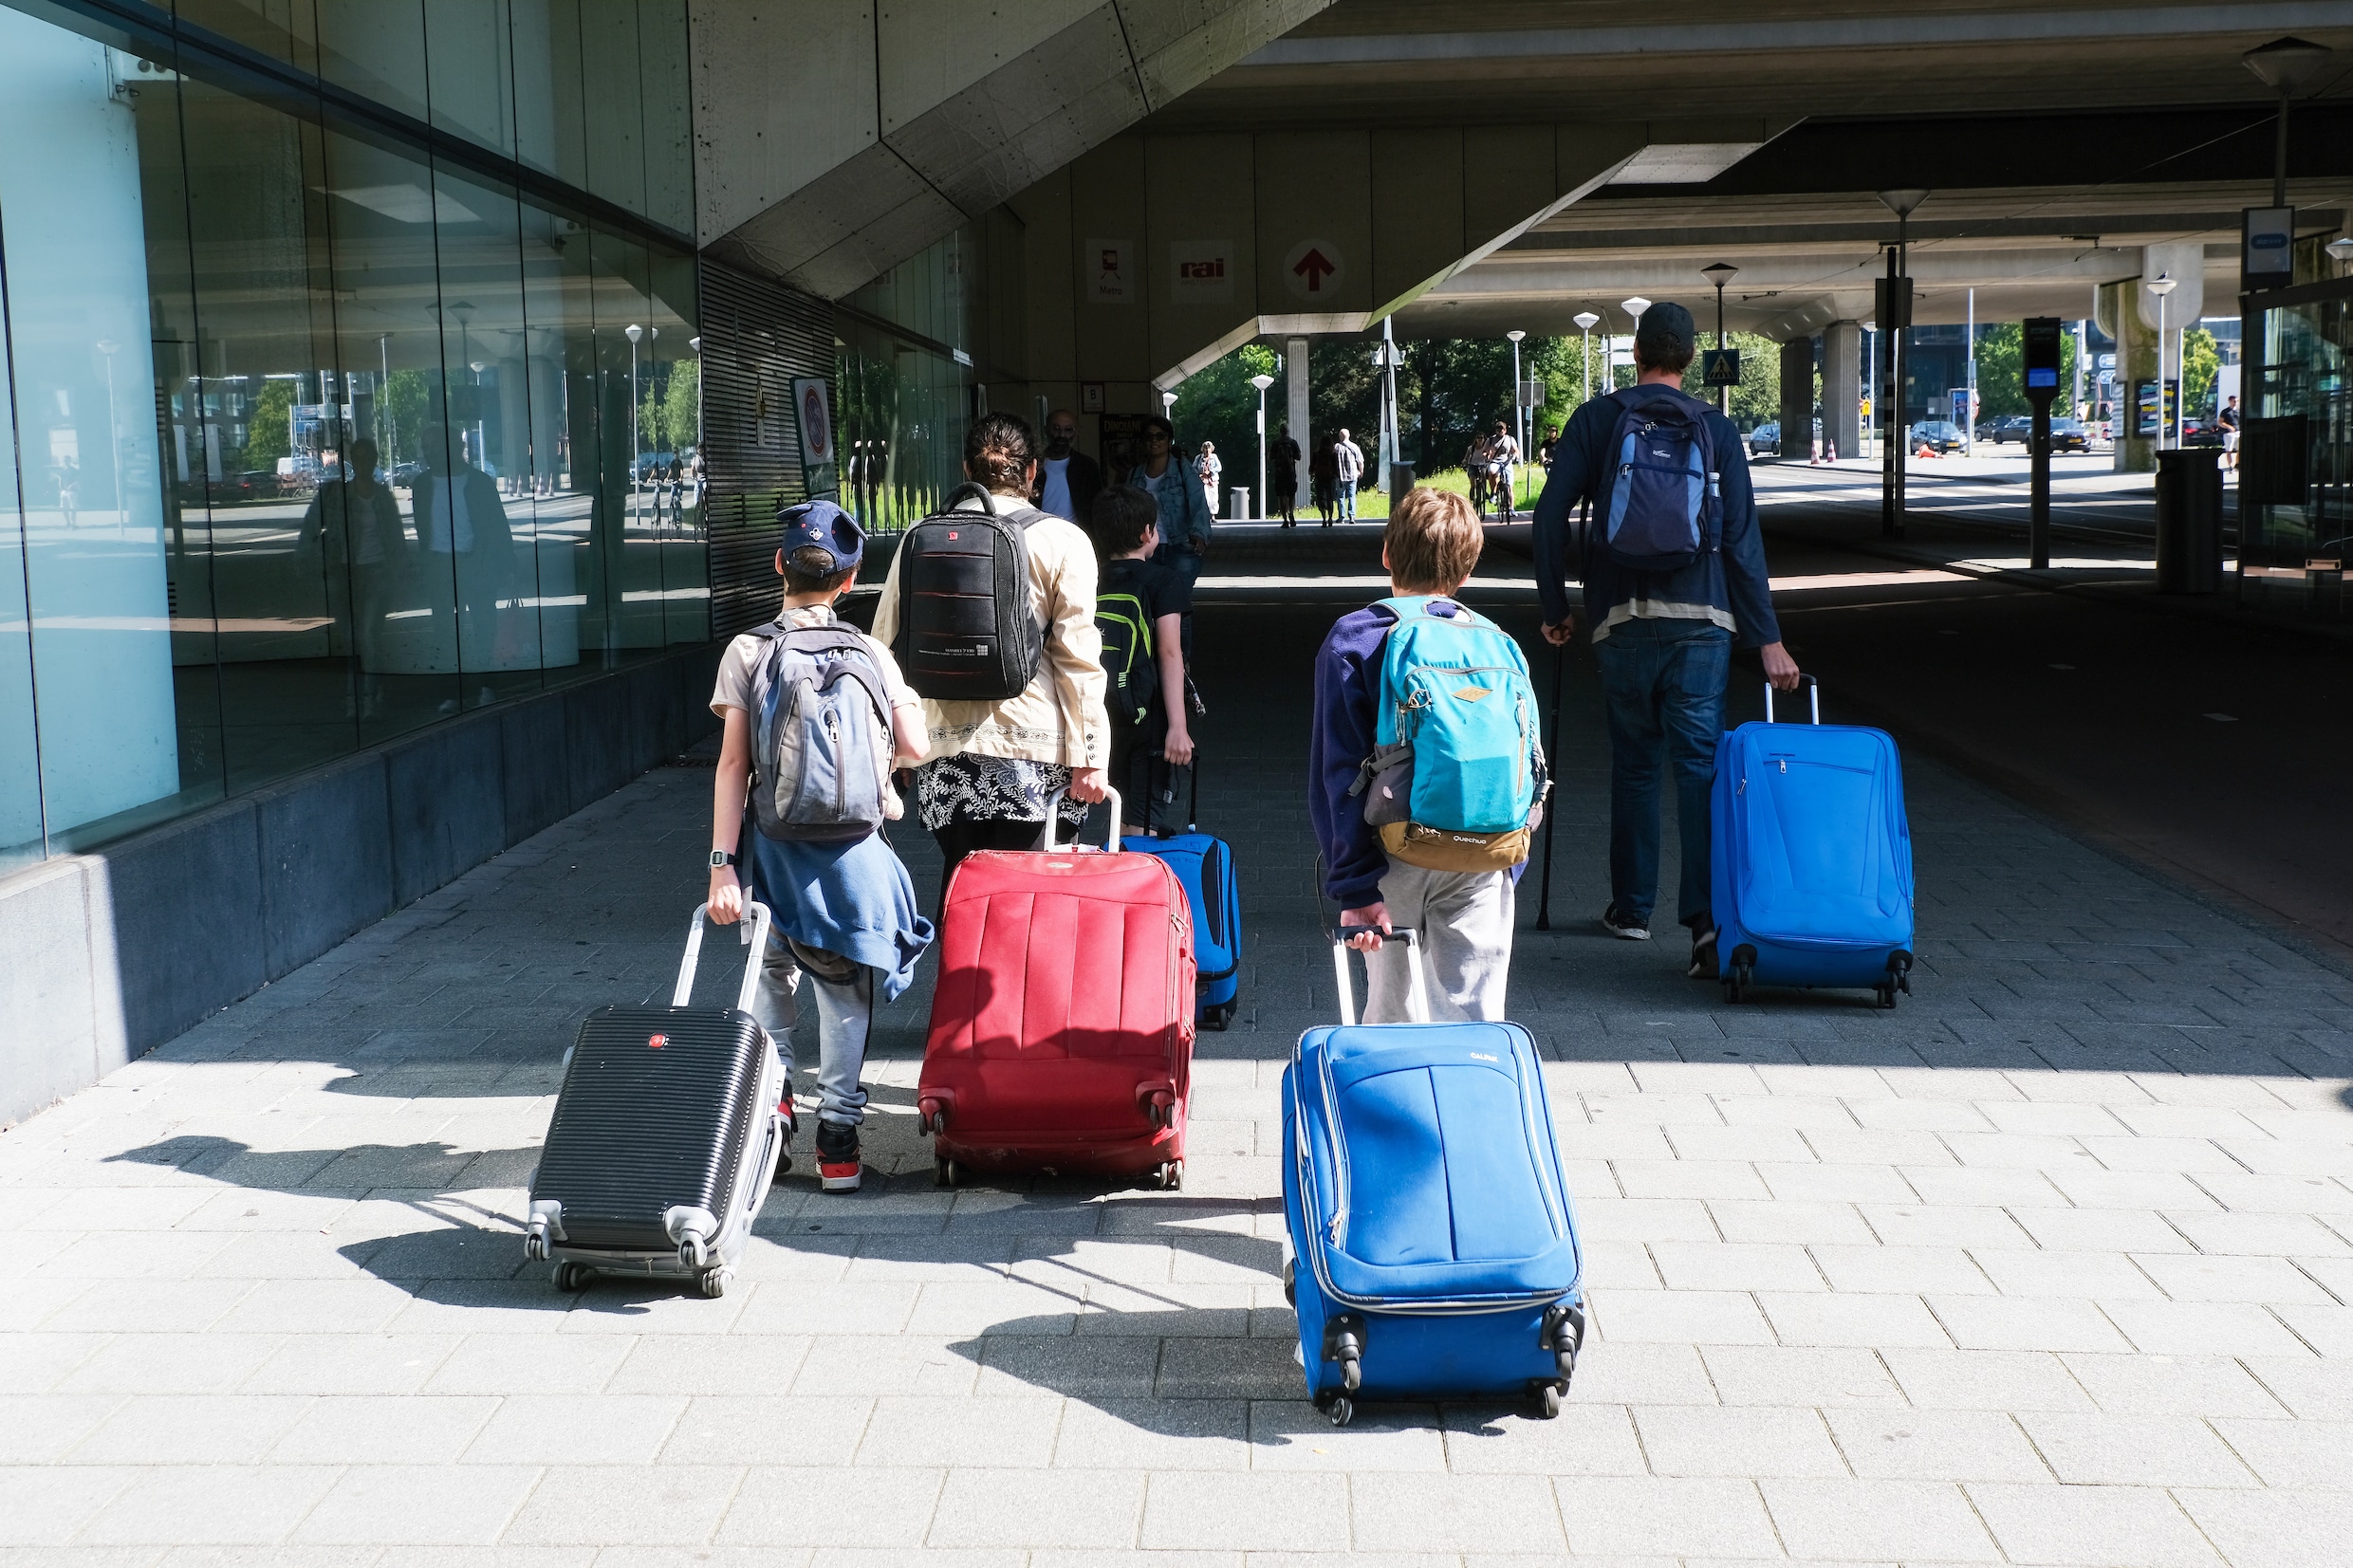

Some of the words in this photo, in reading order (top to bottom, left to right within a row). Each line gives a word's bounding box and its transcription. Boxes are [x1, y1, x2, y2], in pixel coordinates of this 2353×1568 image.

[1180, 257, 1224, 278] rai
[1100, 286, 1122, 295] Metro
[1090, 389, 1097, 399] B
